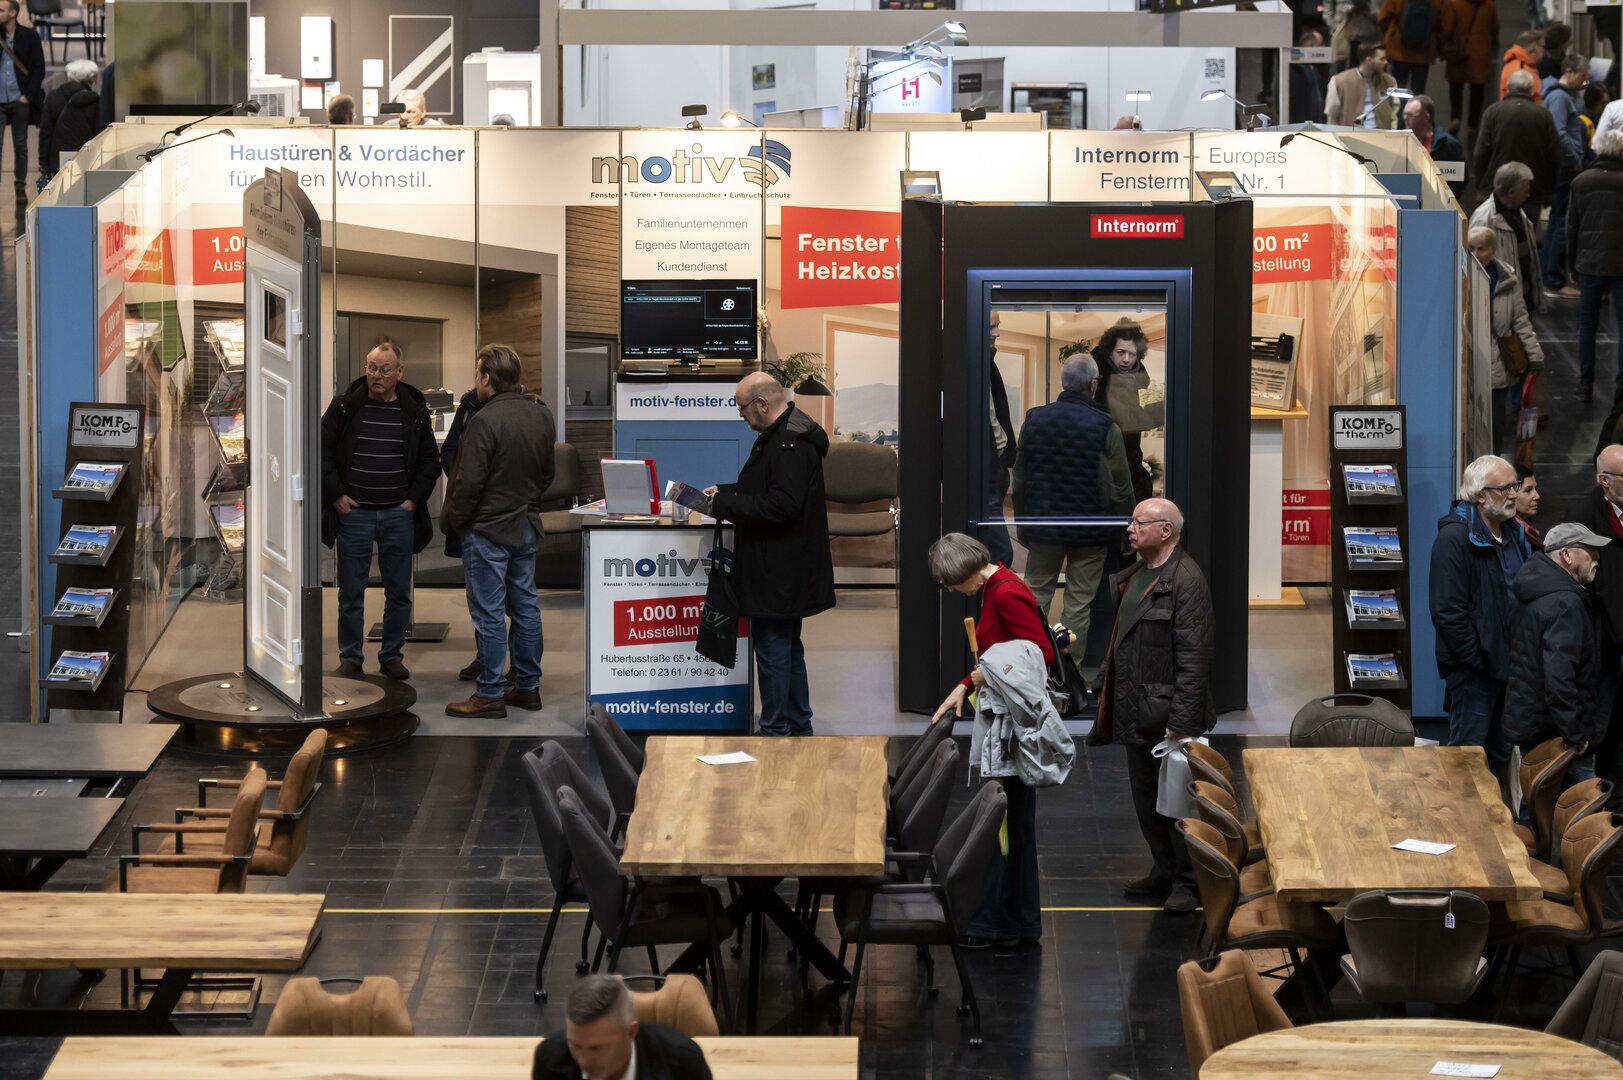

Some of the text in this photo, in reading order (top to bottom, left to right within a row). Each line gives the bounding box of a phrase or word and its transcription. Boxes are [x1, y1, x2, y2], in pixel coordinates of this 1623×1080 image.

[230, 144, 466, 162] Haustüren & Vordächer
[1075, 147, 1179, 163] Internorm
[1209, 147, 1287, 167] Europas
[592, 142, 736, 183] motiv
[230, 170, 256, 187] für
[337, 170, 432, 188] Wohnstil.
[1100, 172, 1285, 189] Fensterm Nr. 1
[630, 190, 651, 198] Türen
[660, 191, 721, 199] Terrassendächer
[637, 218, 748, 229] Familienunternehmen
[1097, 218, 1177, 233] Internorm
[635, 240, 750, 252] Eigenes Montageteam
[798, 233, 889, 252] Fenster
[657, 261, 728, 272] Kundendienst
[630, 395, 737, 407] motiv-fenster.d
[84, 427, 120, 437] therm
[1345, 429, 1384, 439] therm
[1290, 493, 1306, 503] für
[1289, 534, 1310, 542] Türen
[603, 549, 699, 577] motiv
[627, 605, 676, 622] 1.000
[628, 625, 699, 640] Ausstellun
[601, 654, 671, 663] Hubertusstraße
[673, 654, 685, 663] 65
[611, 667, 647, 677] Telefon:
[606, 700, 734, 714] motiv-fenster.de
